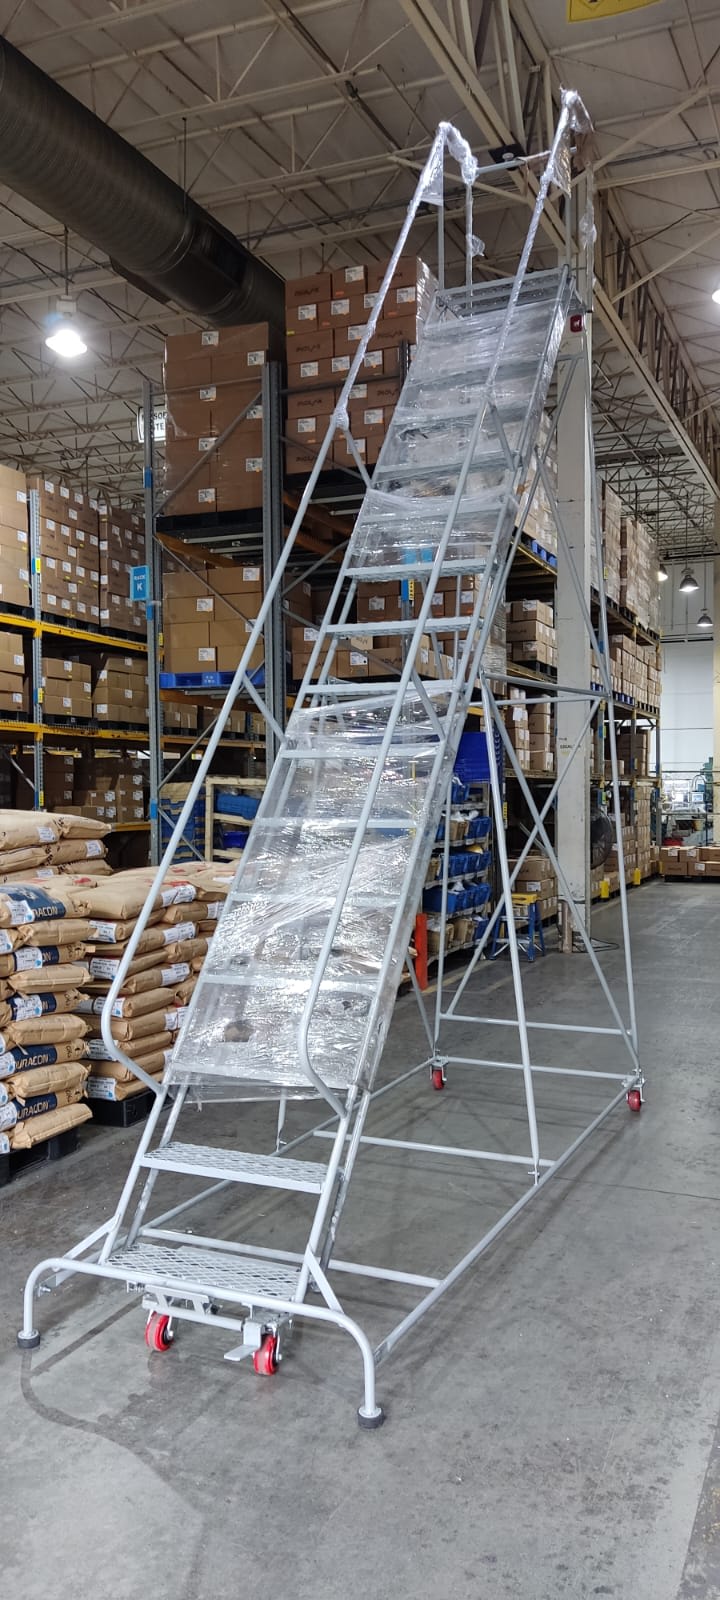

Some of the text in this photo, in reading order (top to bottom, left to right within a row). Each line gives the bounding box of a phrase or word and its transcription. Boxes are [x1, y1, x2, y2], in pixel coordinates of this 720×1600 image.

[136, 582, 143, 591] K
[15, 1054, 49, 1070] URACON
[17, 1101, 49, 1120] URACON
